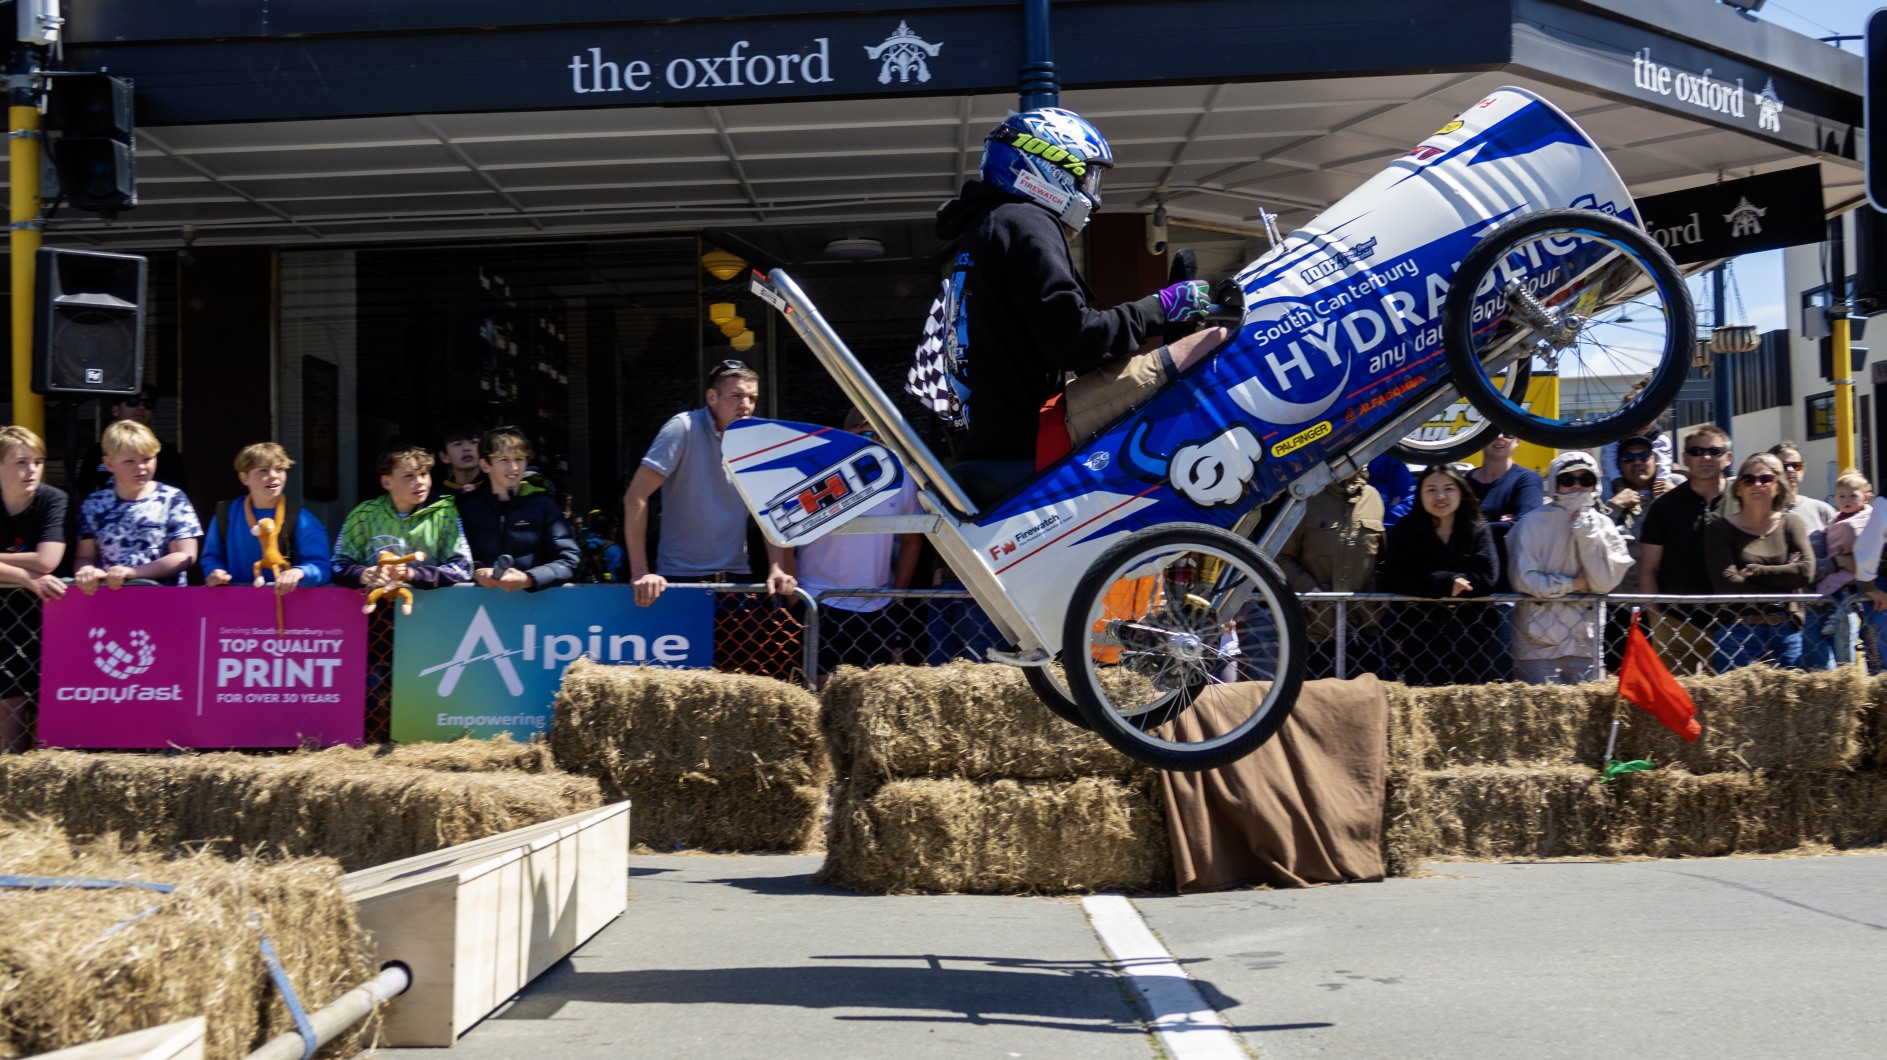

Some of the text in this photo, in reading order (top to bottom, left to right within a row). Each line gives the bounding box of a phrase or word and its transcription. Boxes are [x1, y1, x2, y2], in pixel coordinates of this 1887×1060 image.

[567, 37, 834, 93] the oxford
[1632, 47, 1745, 118] the oxford
[1011, 132, 1087, 176] 100%
[1020, 179, 1064, 205] FIREWATCH
[1645, 212, 1704, 249] ford
[1301, 252, 1346, 285] 100%
[1254, 258, 1419, 347] South Canterbury
[1369, 342, 1406, 374] any
[1473, 291, 1508, 323] any
[1521, 266, 1561, 297] our
[1360, 375, 1427, 415] ALFAGOMMA
[1275, 423, 1329, 454] PALFINGER
[1015, 514, 1060, 542] Firewatch
[219, 638, 345, 657] TOP QUALITY
[252, 627, 276, 635] South
[278, 628, 324, 636] anterbury
[437, 605, 690, 697] Alpine
[217, 658, 342, 688] PRINT
[56, 684, 183, 704] copyfast
[216, 693, 340, 703] FOR OVER 30 YEARS
[437, 712, 546, 729] Empowering
